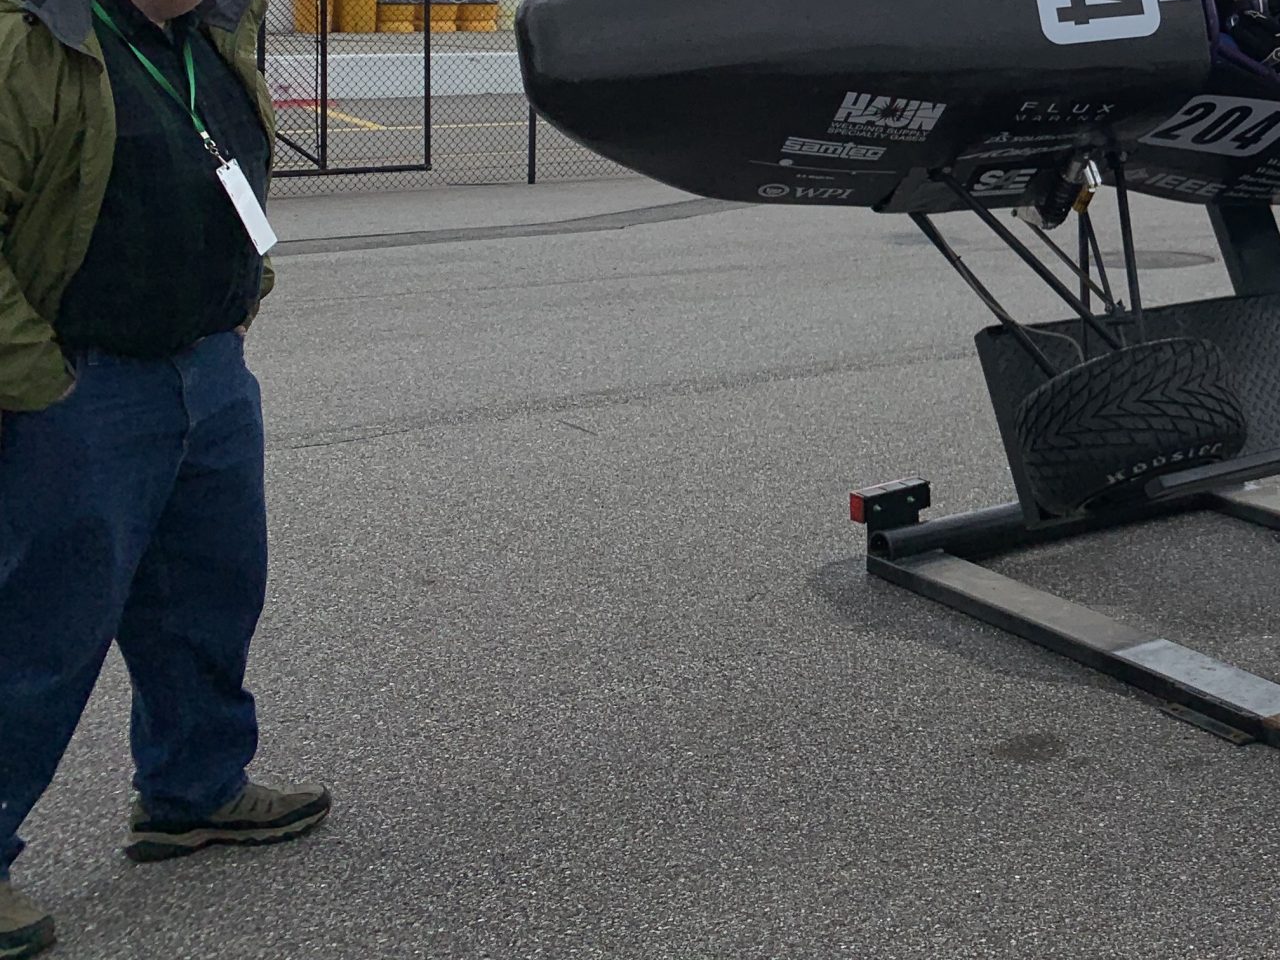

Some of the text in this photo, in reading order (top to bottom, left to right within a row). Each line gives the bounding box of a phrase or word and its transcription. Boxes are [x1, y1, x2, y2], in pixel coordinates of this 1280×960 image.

[833, 91, 948, 131] HAUN
[1020, 101, 1116, 114] FLUX
[826, 126, 888, 139] SPECIALTY
[831, 121, 931, 137] WELDING SUPPLY
[1144, 172, 1228, 197] IEEE
[794, 186, 856, 199] WPI
